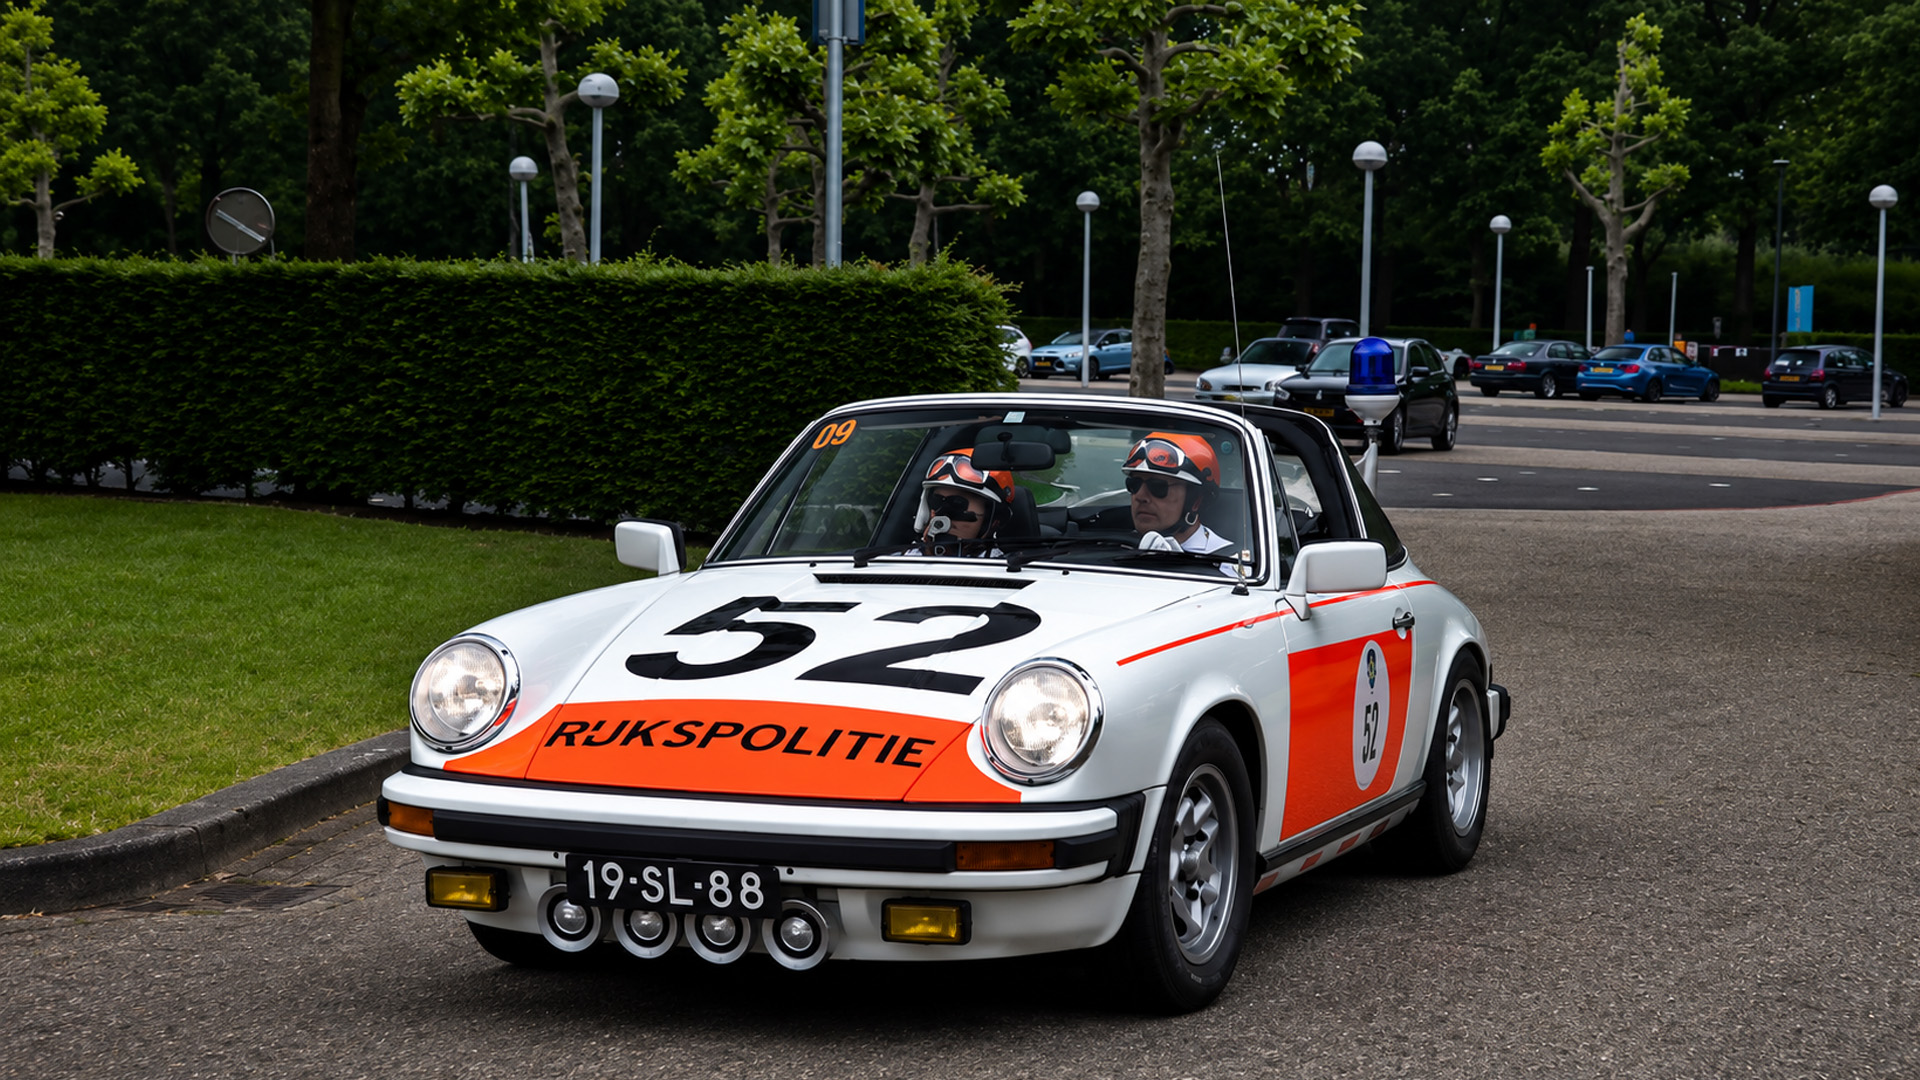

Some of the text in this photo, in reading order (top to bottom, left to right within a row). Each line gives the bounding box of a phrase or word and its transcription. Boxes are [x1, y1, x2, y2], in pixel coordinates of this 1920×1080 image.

[813, 420, 857, 449] 09
[625, 595, 1041, 695] 52
[545, 719, 936, 768] RIJKSPOLITIE
[1362, 702, 1379, 763] 52
[583, 860, 764, 909] 19-SL-88
